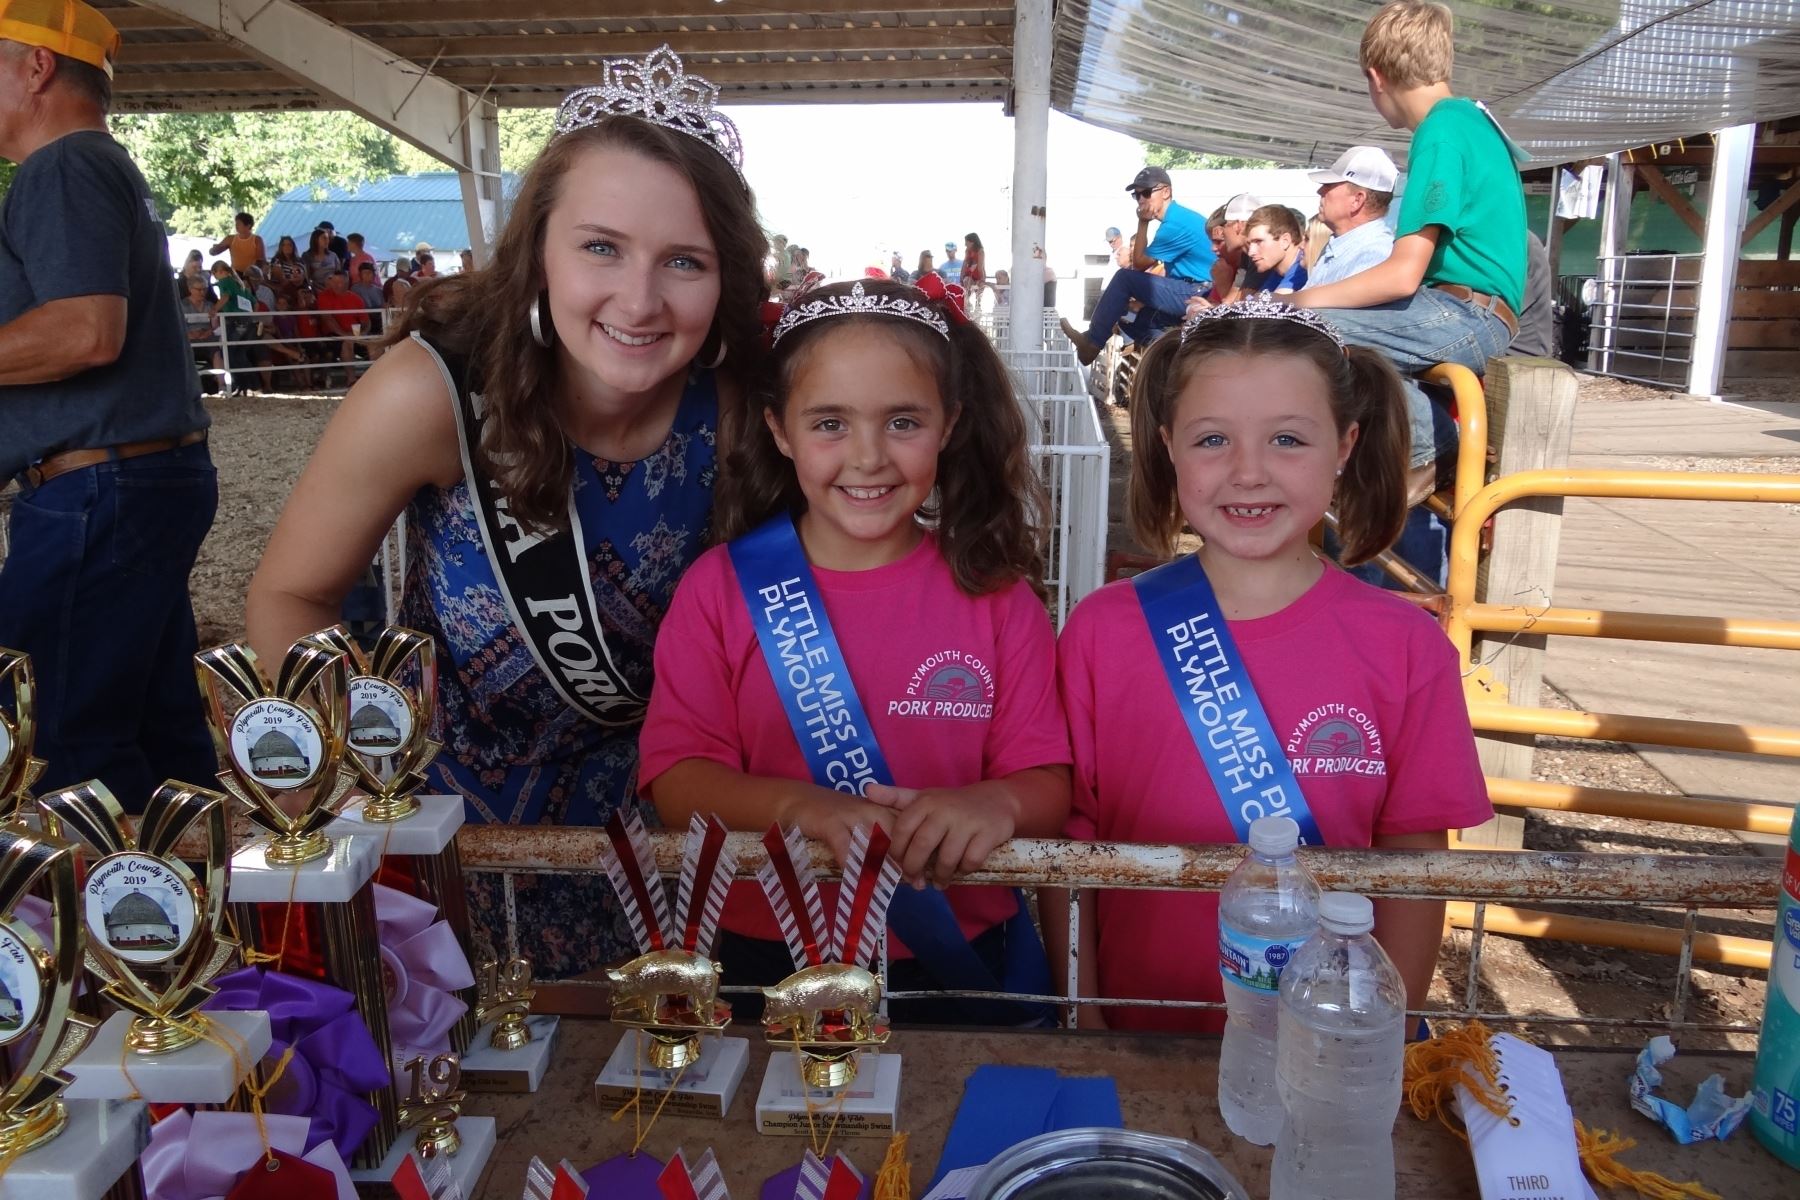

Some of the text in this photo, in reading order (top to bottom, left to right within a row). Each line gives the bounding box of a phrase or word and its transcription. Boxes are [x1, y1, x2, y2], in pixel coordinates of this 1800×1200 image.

[758, 584, 838, 755] PLYMOUTH
[781, 577, 829, 668] LITTLE
[815, 672, 857, 741] MISS
[907, 650, 995, 698] PLYMOUTH COUNTY
[361, 692, 378, 700] 2019
[364, 681, 389, 694] County
[1188, 613, 1241, 704] LITTLE
[1227, 709, 1274, 779] MISS
[236, 703, 313, 734] Plymouth County Fair
[263, 716, 283, 725] 2019
[888, 701, 932, 716] PORK
[1167, 622, 1252, 794] PLYMOUTH
[1287, 703, 1382, 755] PLYMOUTH COUNTY
[89, 860, 184, 897] Plymouth County Fair
[123, 876, 147, 885] 2019
[1, 937, 25, 965] Fair
[1268, 952, 1286, 960] 1987
[404, 1053, 461, 1099] 19
[1776, 1092, 1796, 1121] 75
[1507, 1175, 1550, 1191] THIRD
